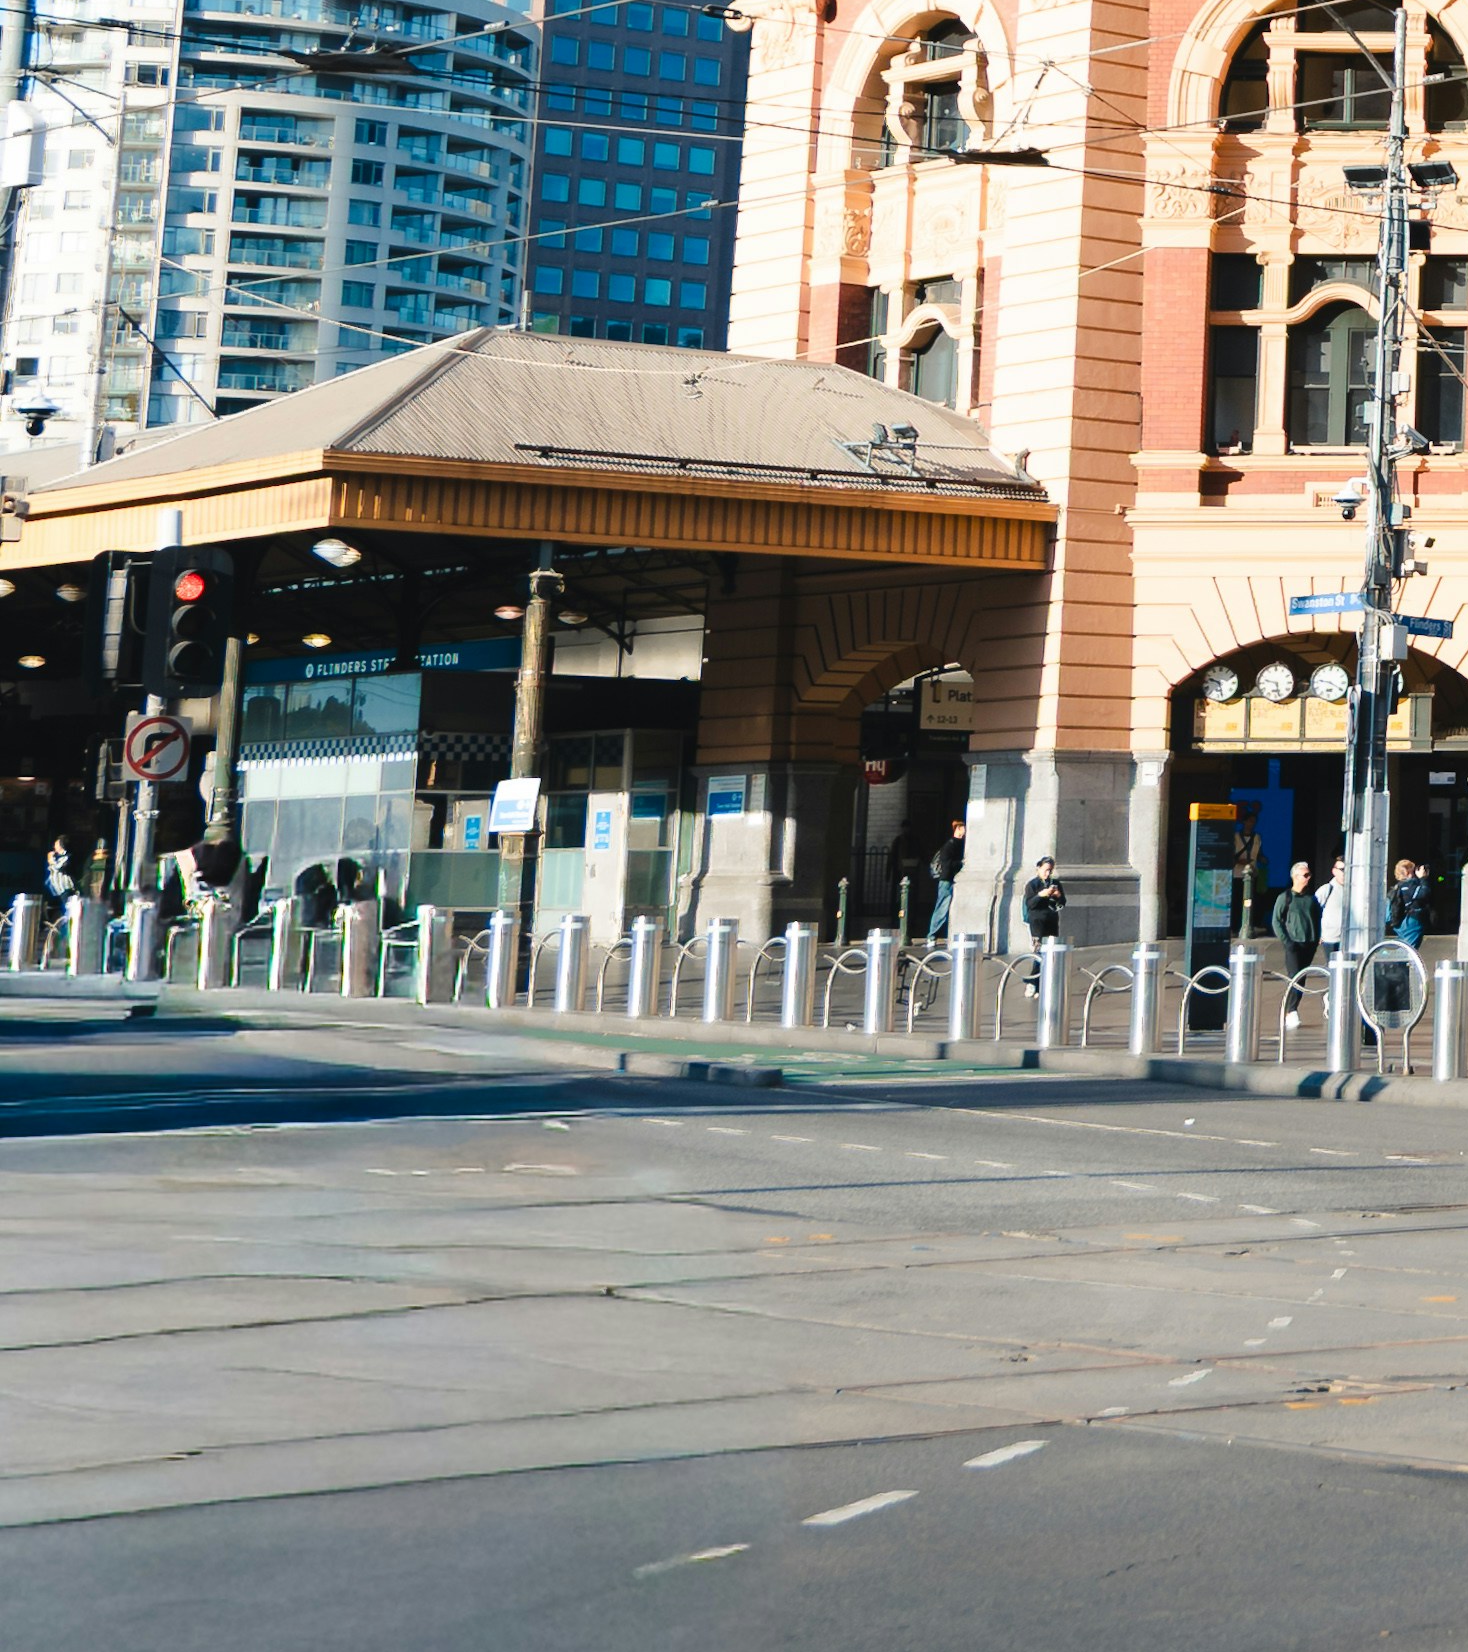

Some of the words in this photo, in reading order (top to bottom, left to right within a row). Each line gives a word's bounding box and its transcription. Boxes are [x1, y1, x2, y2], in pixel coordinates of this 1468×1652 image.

[1291, 595, 1334, 610] Swanston
[1335, 594, 1345, 607] St
[1409, 617, 1442, 632] Flinders
[317, 660, 367, 677] FLINDERS
[415, 652, 459, 667] TATION
